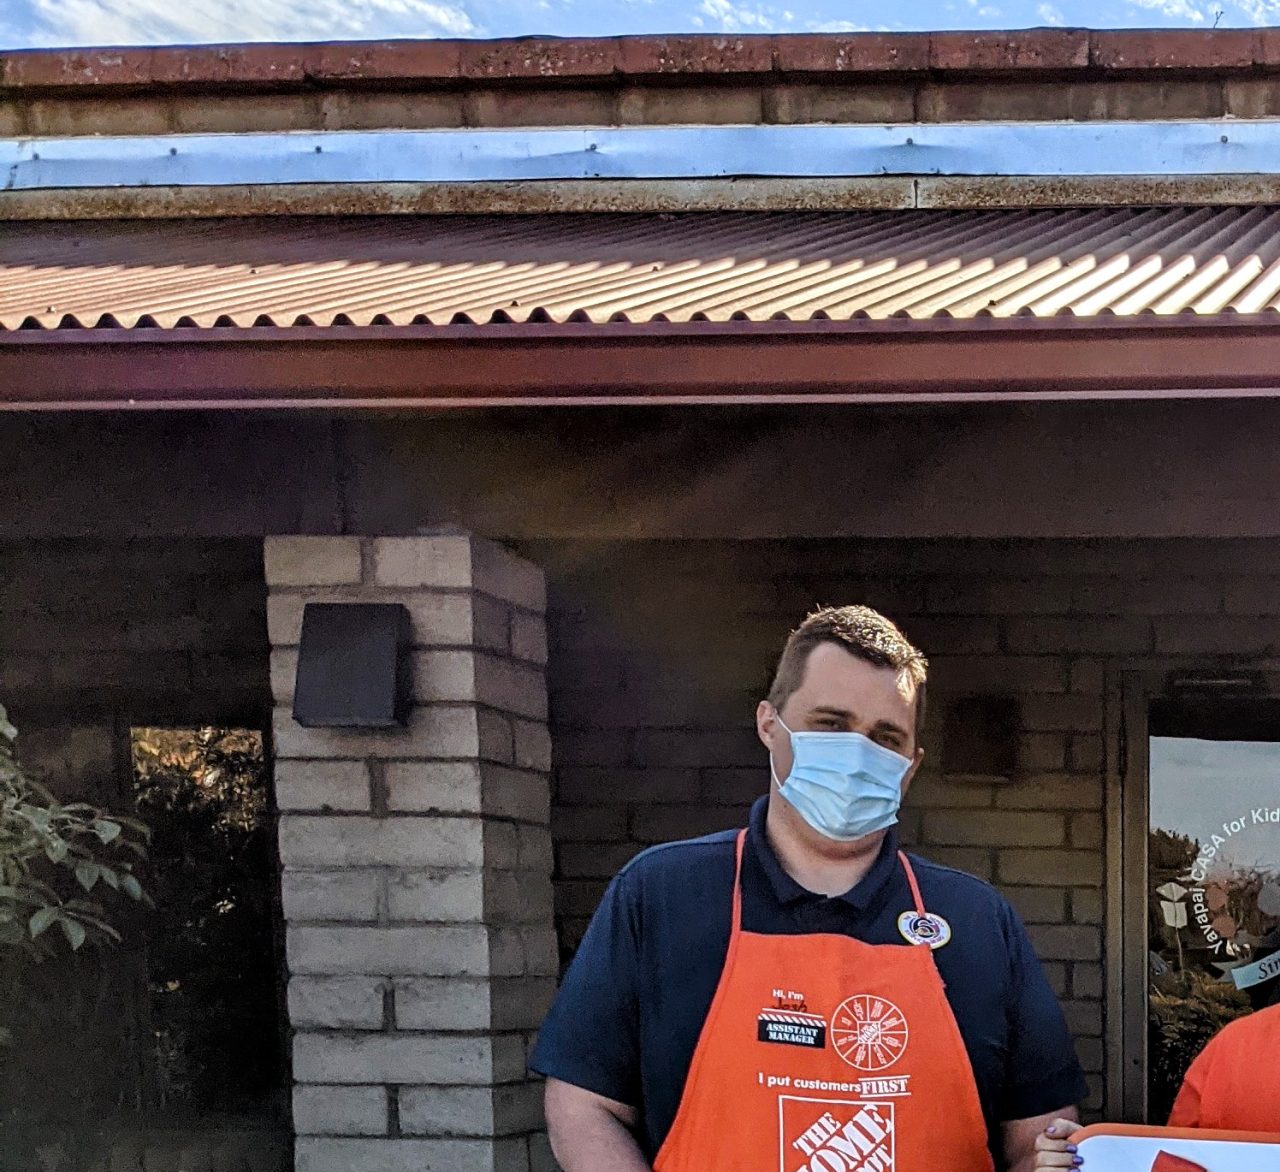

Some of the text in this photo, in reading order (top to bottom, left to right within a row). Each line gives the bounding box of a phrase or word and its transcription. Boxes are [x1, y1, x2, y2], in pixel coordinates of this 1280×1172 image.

[1222, 815, 1247, 836] for
[1191, 833, 1225, 881] CASA
[1188, 887, 1223, 955] Yavapai
[772, 988, 805, 1001] Hi, I'm
[766, 1022, 819, 1037] ASSISTANT
[768, 1031, 815, 1045] MANAGER
[758, 1072, 908, 1094] I put customers FIRST
[792, 1112, 842, 1157] THE
